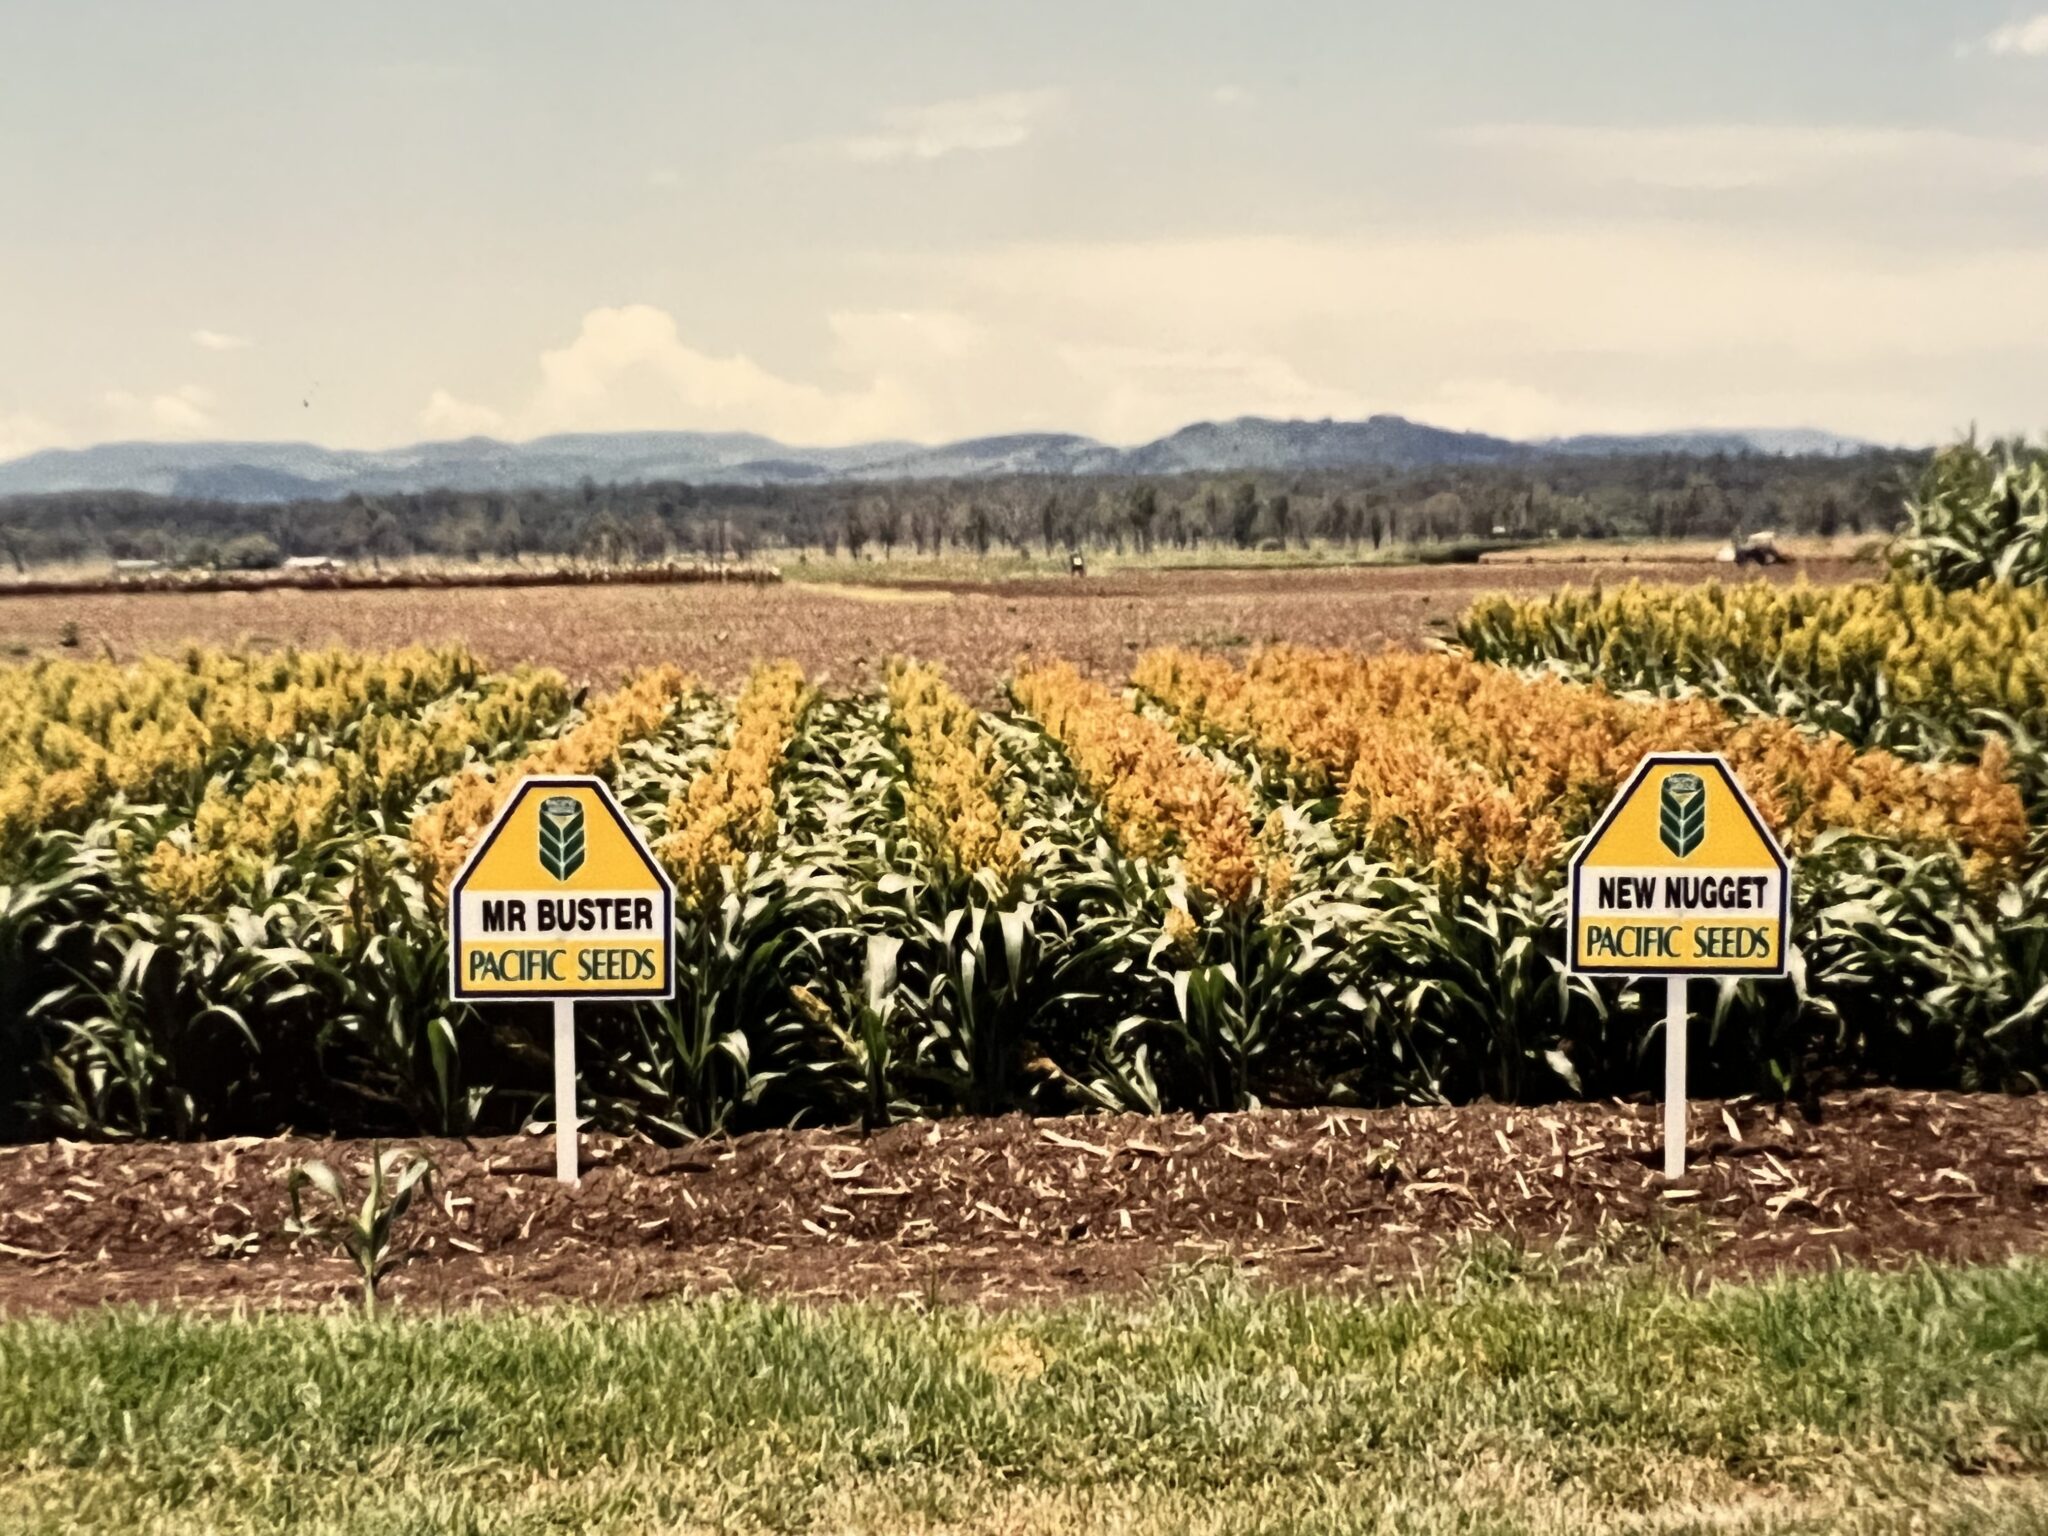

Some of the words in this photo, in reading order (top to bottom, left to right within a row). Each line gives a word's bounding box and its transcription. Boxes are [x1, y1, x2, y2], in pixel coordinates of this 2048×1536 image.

[1599, 877, 1656, 909] NEW
[1665, 876, 1768, 909] NUGGET
[482, 899, 526, 932] MR
[537, 898, 653, 931] BUSTER
[1587, 926, 1682, 957] PACIFIC
[1693, 926, 1770, 958] SEEDS
[470, 949, 566, 981] PACIFIC
[578, 949, 655, 981] SEEDS
